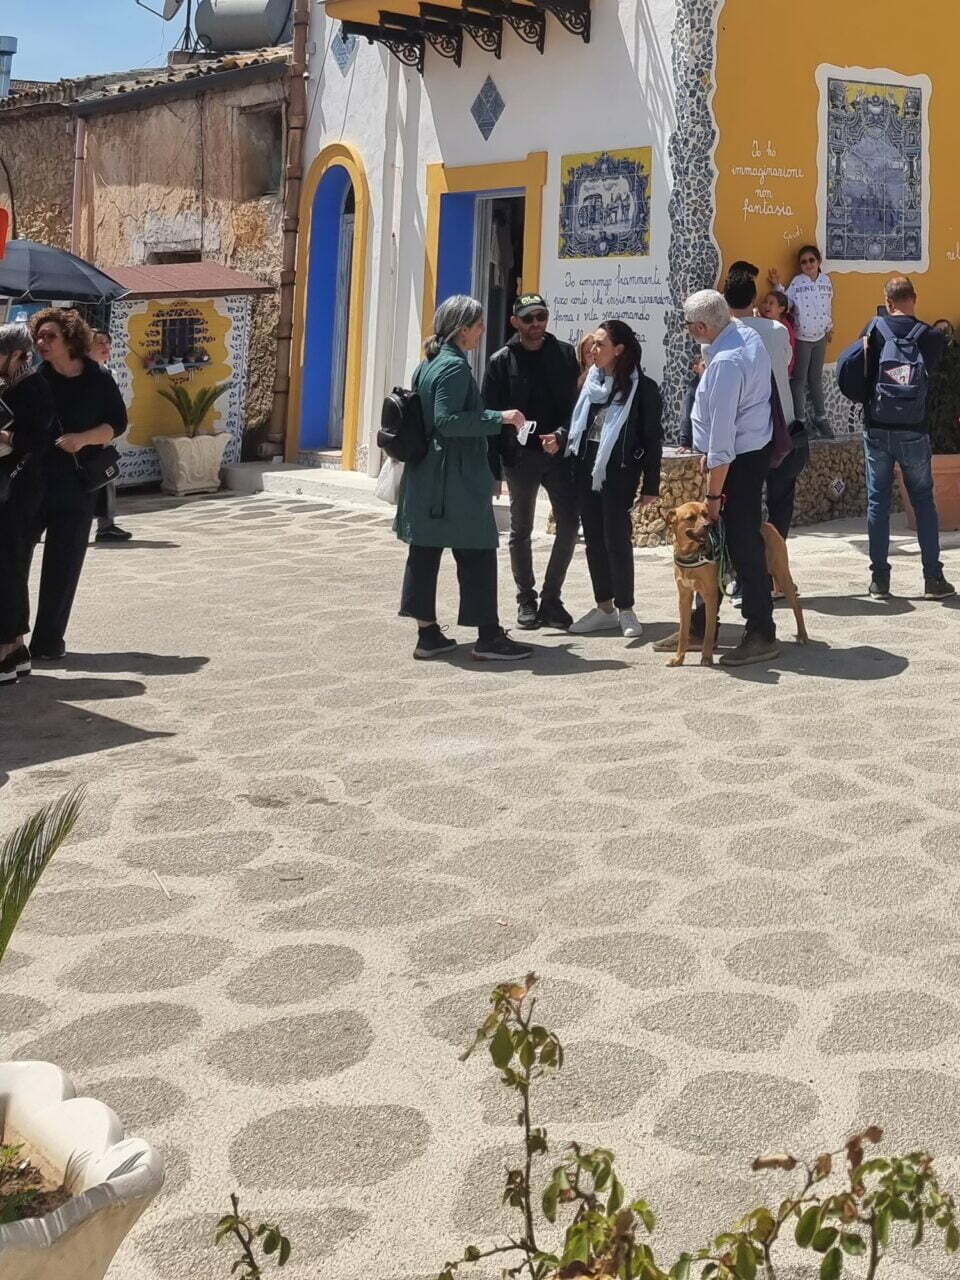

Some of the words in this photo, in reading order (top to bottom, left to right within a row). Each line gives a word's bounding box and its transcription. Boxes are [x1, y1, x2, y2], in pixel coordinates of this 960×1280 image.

[766, 139, 777, 157] ho
[754, 188, 773, 199] non
[743, 198, 793, 222] fantasia
[579, 277, 613, 296] compongo
[612, 263, 663, 298] frammenti
[592, 290, 604, 306] che
[606, 294, 638, 307] insieme
[583, 307, 599, 321] vita
